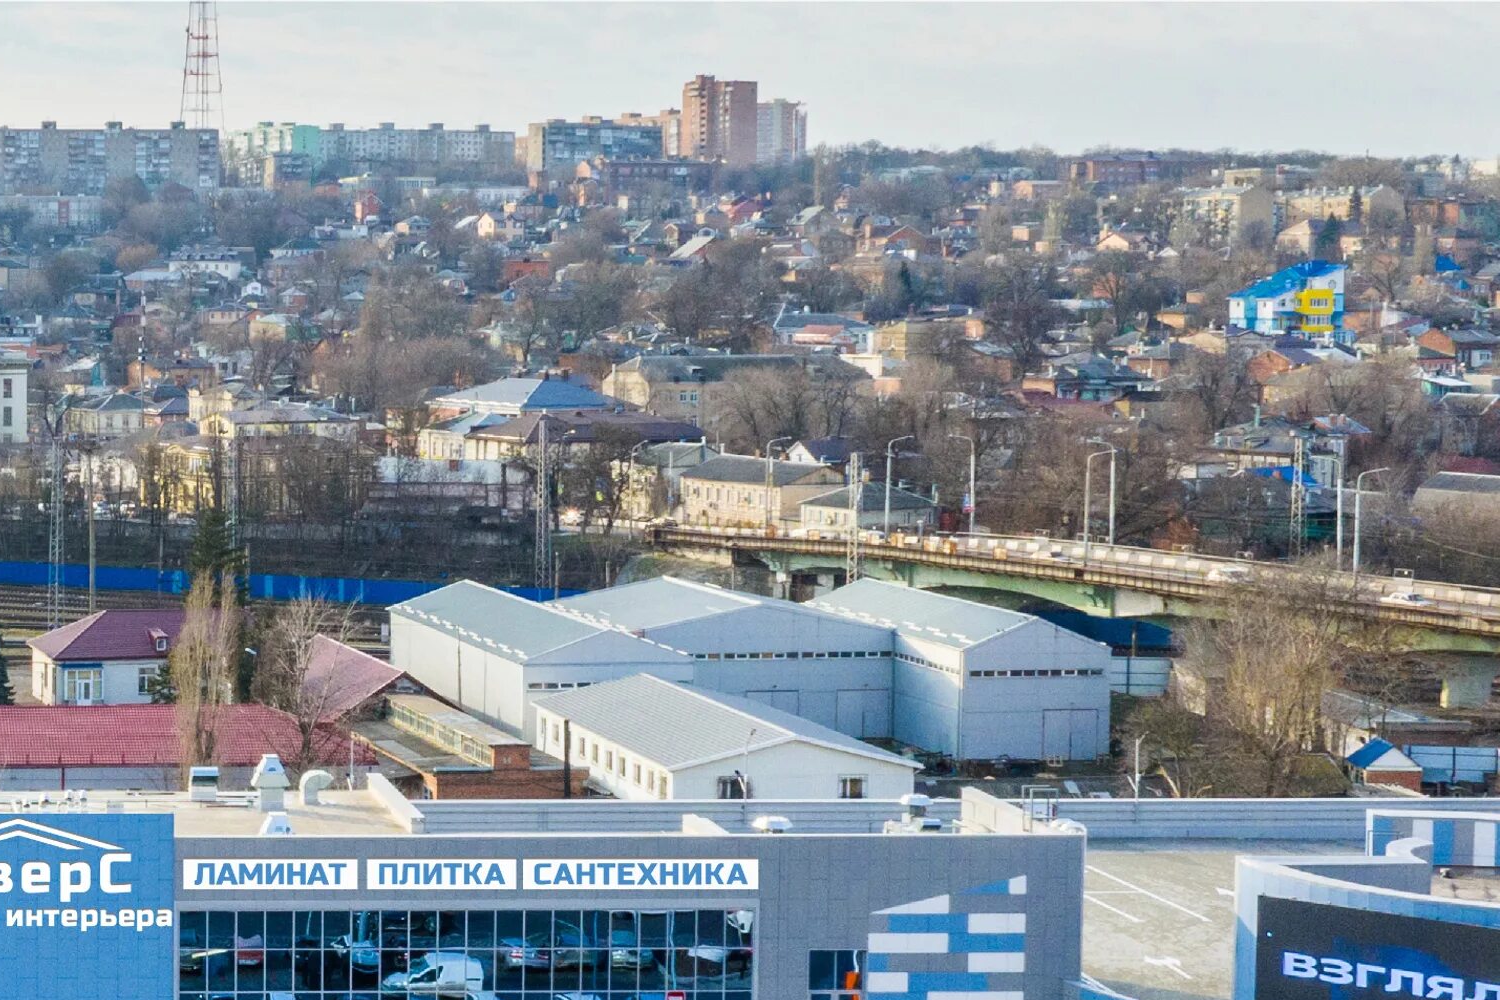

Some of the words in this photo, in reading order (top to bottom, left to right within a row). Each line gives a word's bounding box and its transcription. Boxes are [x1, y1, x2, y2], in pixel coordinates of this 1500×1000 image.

[194, 862, 348, 886] ЛАМИНАТ
[378, 862, 506, 886] ПЛИТКА
[534, 862, 748, 886] САНТЕХНИКА
[6, 908, 173, 931] интерьера
